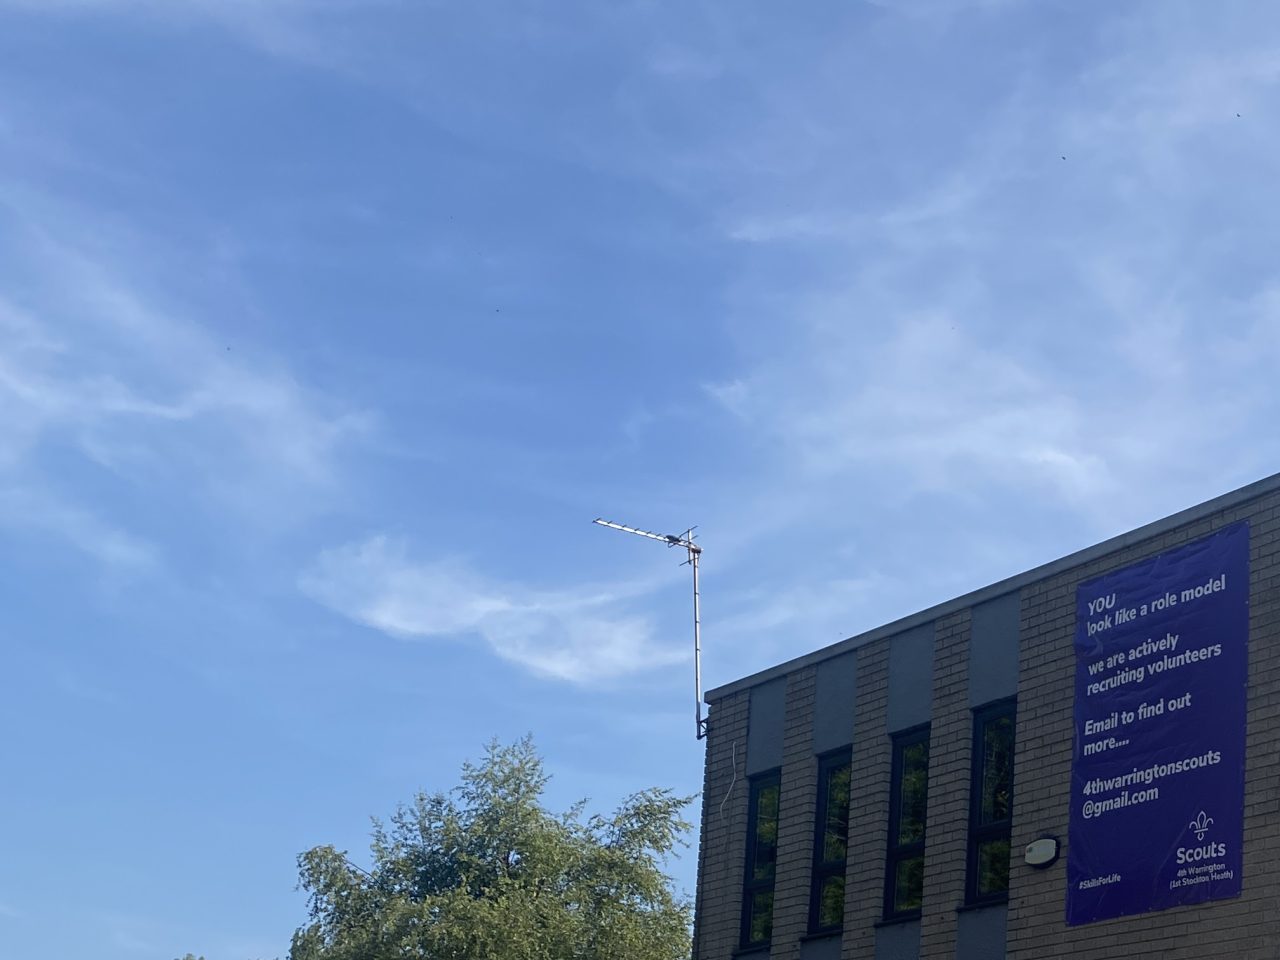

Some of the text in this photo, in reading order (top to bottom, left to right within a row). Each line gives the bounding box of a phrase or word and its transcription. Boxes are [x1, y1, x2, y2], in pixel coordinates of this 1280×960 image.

[1088, 594, 1116, 616] YOU
[1088, 574, 1226, 636] look like a role model
[1087, 643, 1222, 696] recruiting volunteers
[1088, 632, 1179, 676] we are actively
[1084, 692, 1192, 736] Email to find out
[1083, 750, 1221, 796] 4thwarringtonscouts
[1082, 786, 1159, 818] @gmail.com
[1176, 842, 1226, 864] Scouts
[1188, 863, 1226, 876] Warrington
